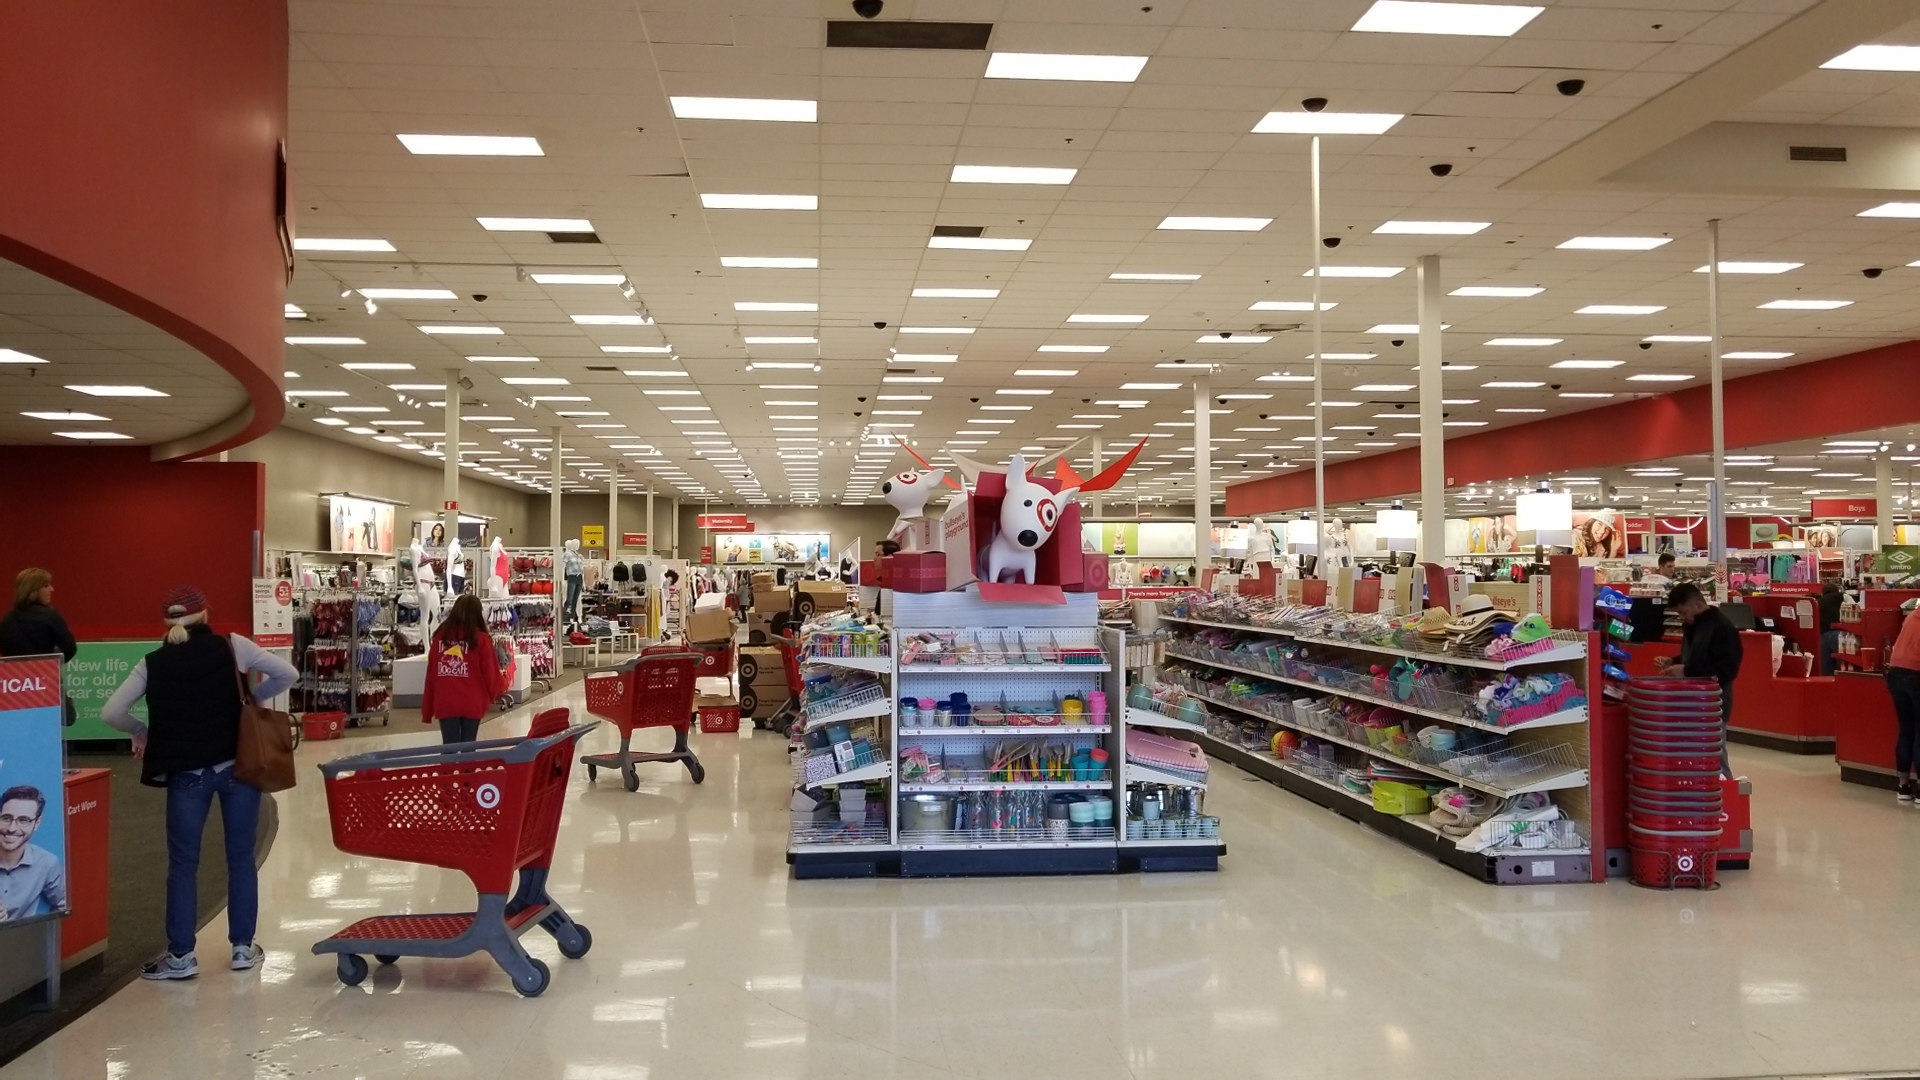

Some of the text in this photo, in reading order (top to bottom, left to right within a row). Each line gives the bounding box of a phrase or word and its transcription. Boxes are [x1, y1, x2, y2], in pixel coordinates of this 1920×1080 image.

[945, 512, 966, 529] bullseye's
[945, 519, 968, 541] playground
[1491, 596, 1516, 607] llseye's
[1604, 593, 1627, 606] Orbit
[67, 657, 128, 672] New life
[0, 677, 46, 694] ICAL
[67, 673, 117, 687] for old
[66, 688, 92, 699] car
[68, 800, 97, 816] Cart Wipes
